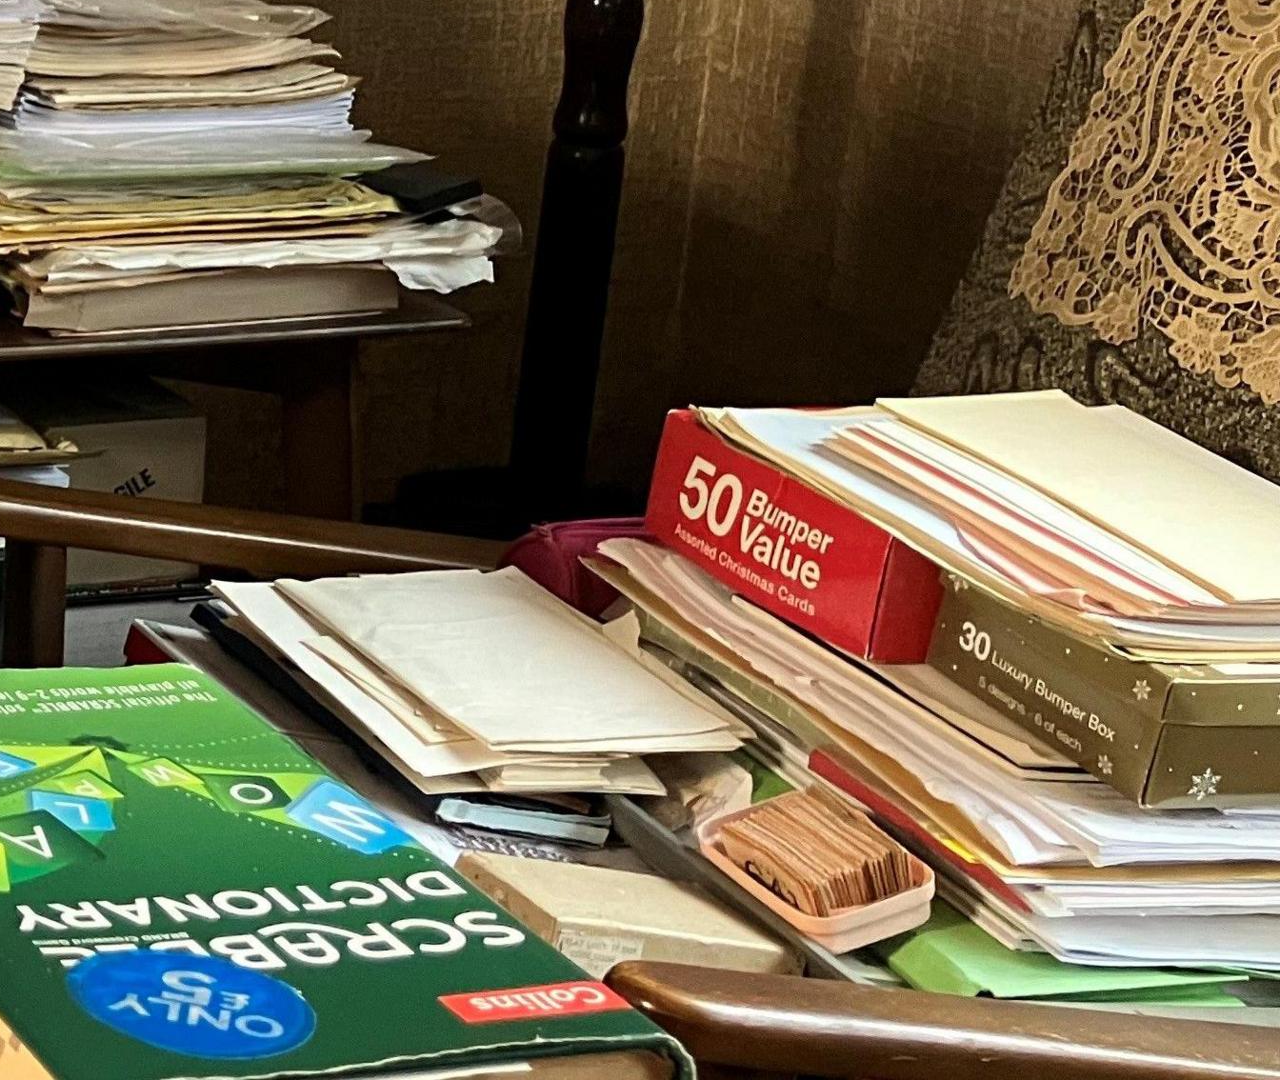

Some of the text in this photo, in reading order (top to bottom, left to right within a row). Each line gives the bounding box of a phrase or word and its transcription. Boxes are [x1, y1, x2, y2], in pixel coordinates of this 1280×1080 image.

[678, 455, 835, 555] 50 Bumper
[673, 523, 817, 618] Assorted Christmas Cards
[739, 512, 822, 591] Value
[50, 685, 102, 699] words
[103, 679, 173, 696] playable
[123, 692, 179, 708] official
[177, 679, 201, 692] all
[186, 690, 219, 704] The
[958, 620, 1117, 743] 30 Luxury Bumper Box
[18, 870, 468, 934] DICTIONARY
[162, 970, 250, 1011] £5
[468, 985, 606, 1012] Collins
[107, 993, 285, 1039] ONLY
